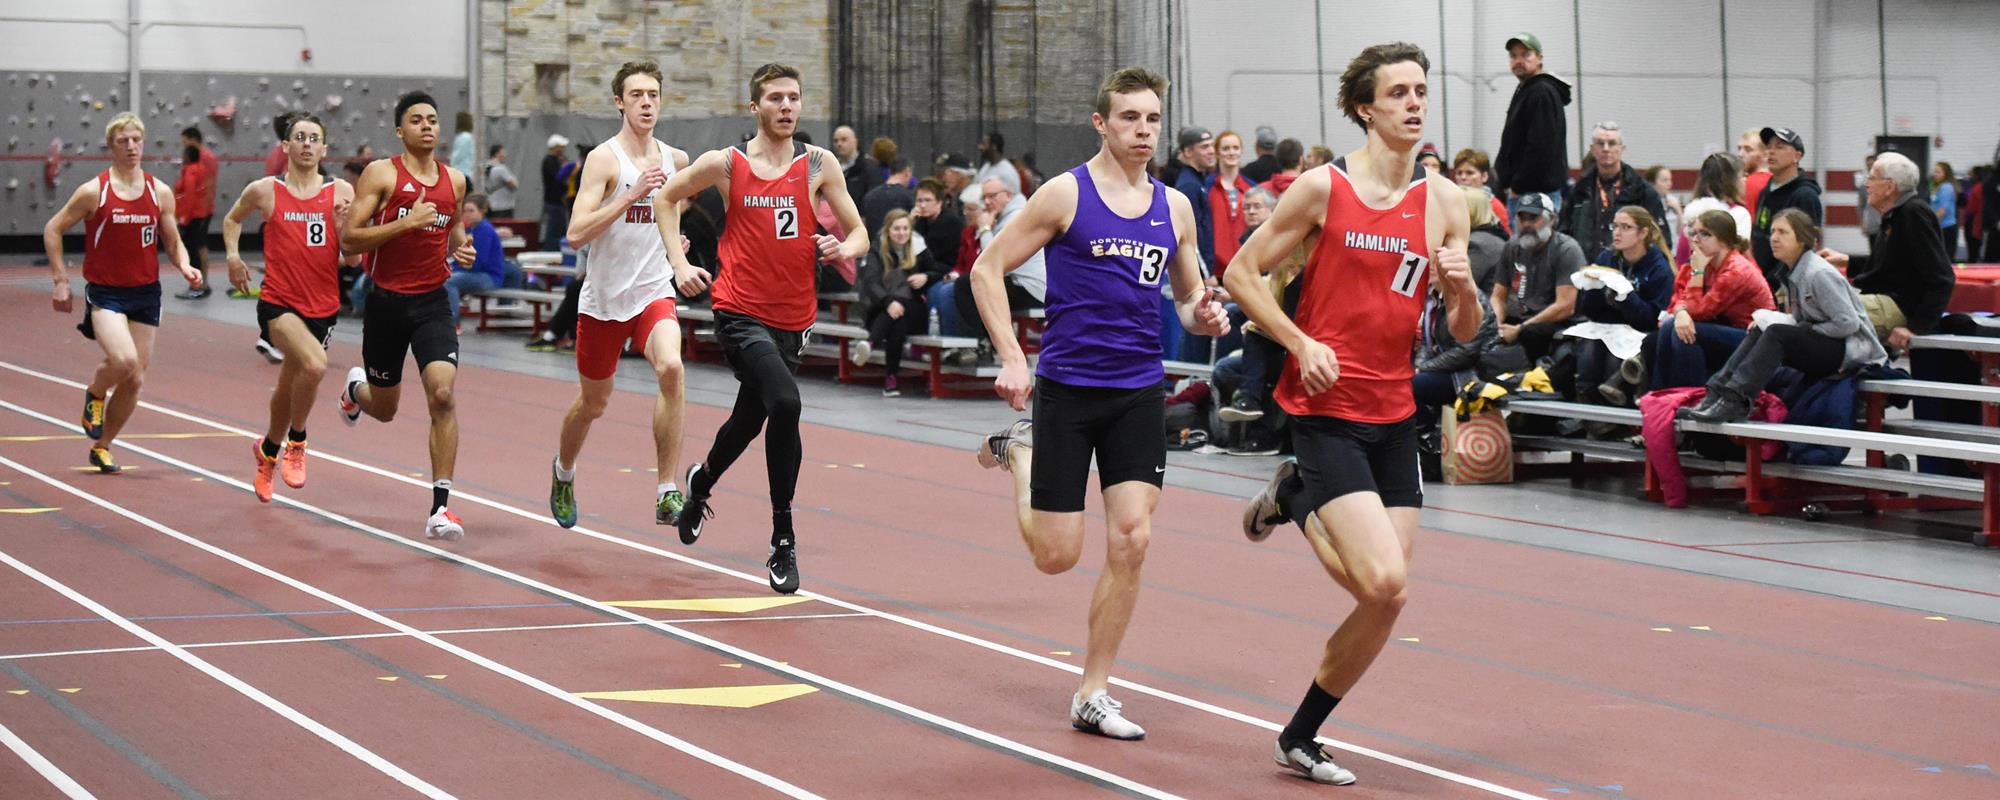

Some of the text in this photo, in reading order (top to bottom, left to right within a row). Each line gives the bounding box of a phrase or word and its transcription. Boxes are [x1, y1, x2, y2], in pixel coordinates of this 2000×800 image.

[744, 195, 795, 208] HAMLINE
[284, 211, 324, 222] HAMLINE
[778, 210, 795, 237] 2
[143, 227, 153, 244] 6
[310, 223, 323, 244] 8
[1090, 237, 1144, 247] NORTHWES
[1345, 231, 1408, 254] HAMLINE
[1091, 242, 1143, 260] EAGL
[1143, 249, 1163, 282] 3
[1402, 257, 1420, 292] 1
[369, 367, 389, 380] BLC
